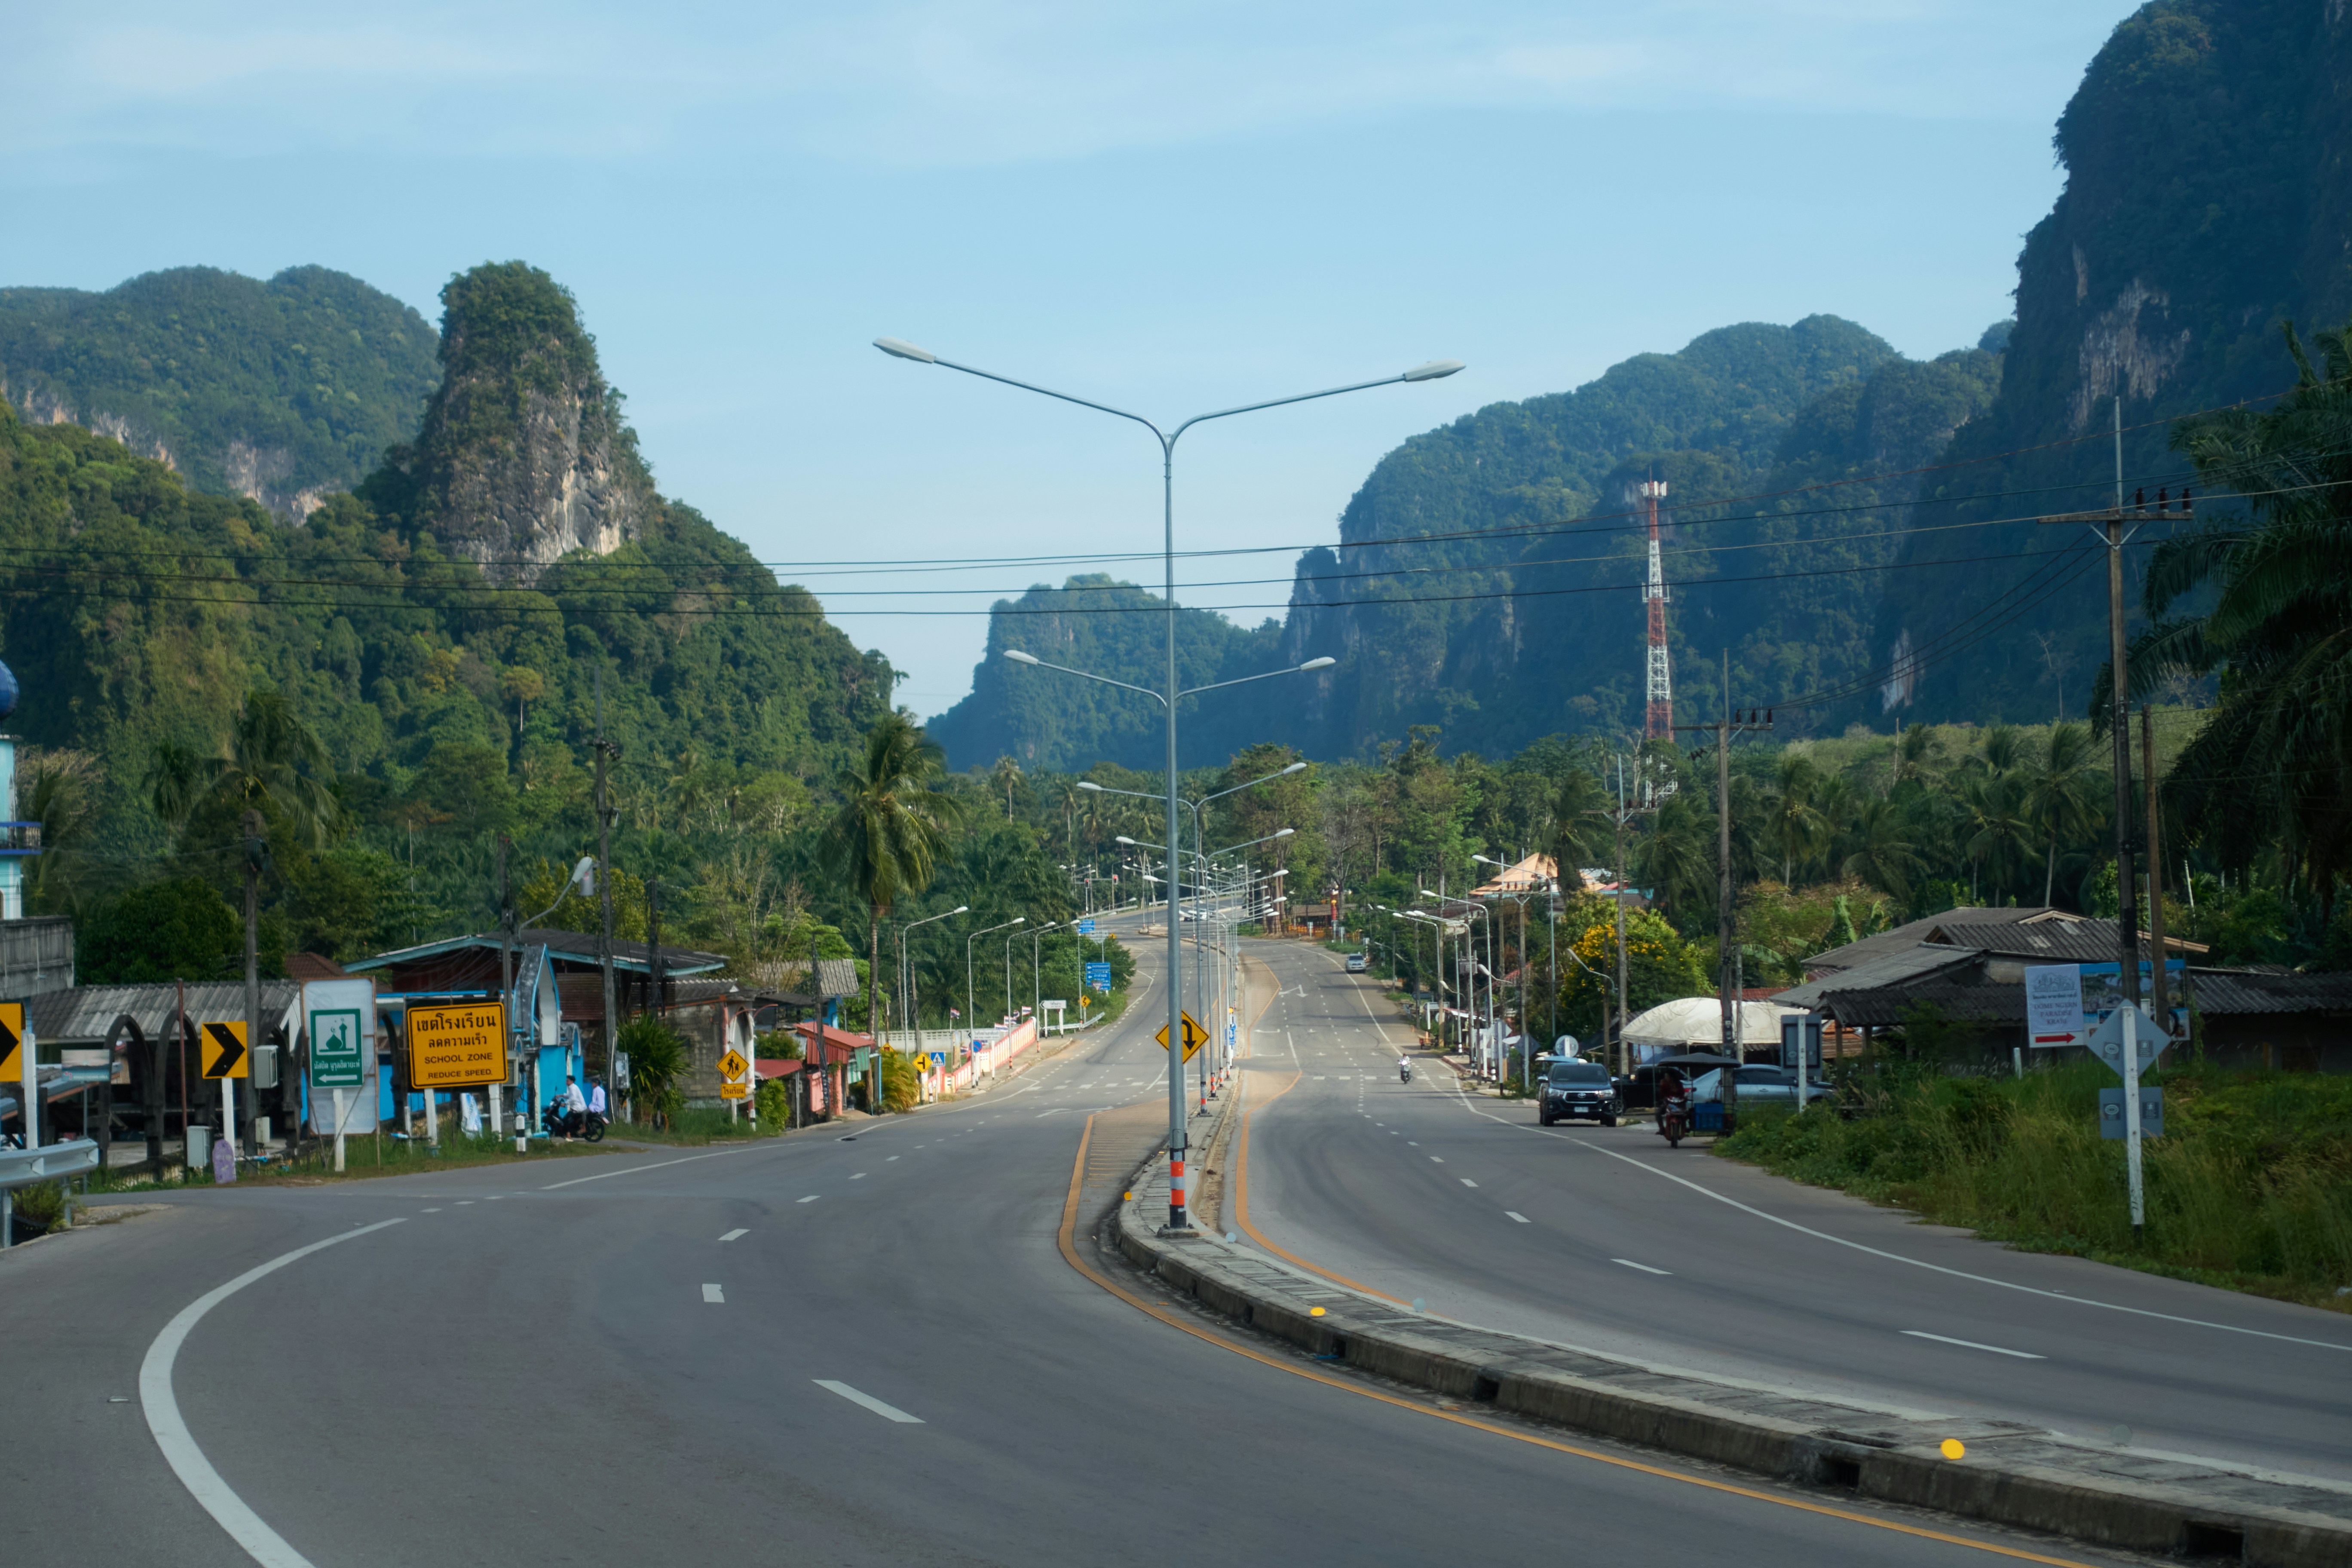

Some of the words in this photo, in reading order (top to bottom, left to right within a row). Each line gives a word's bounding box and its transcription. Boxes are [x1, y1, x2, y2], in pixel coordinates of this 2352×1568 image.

[416, 1012, 496, 1032] เขตโรงเรียน
[428, 1032, 487, 1048] ลดความเร็ว
[424, 1054, 463, 1064] SCHOOL
[467, 1053, 493, 1061] ZONE
[428, 1071, 462, 1079] REDUCE
[722, 1086, 744, 1095] โรงเรียน
